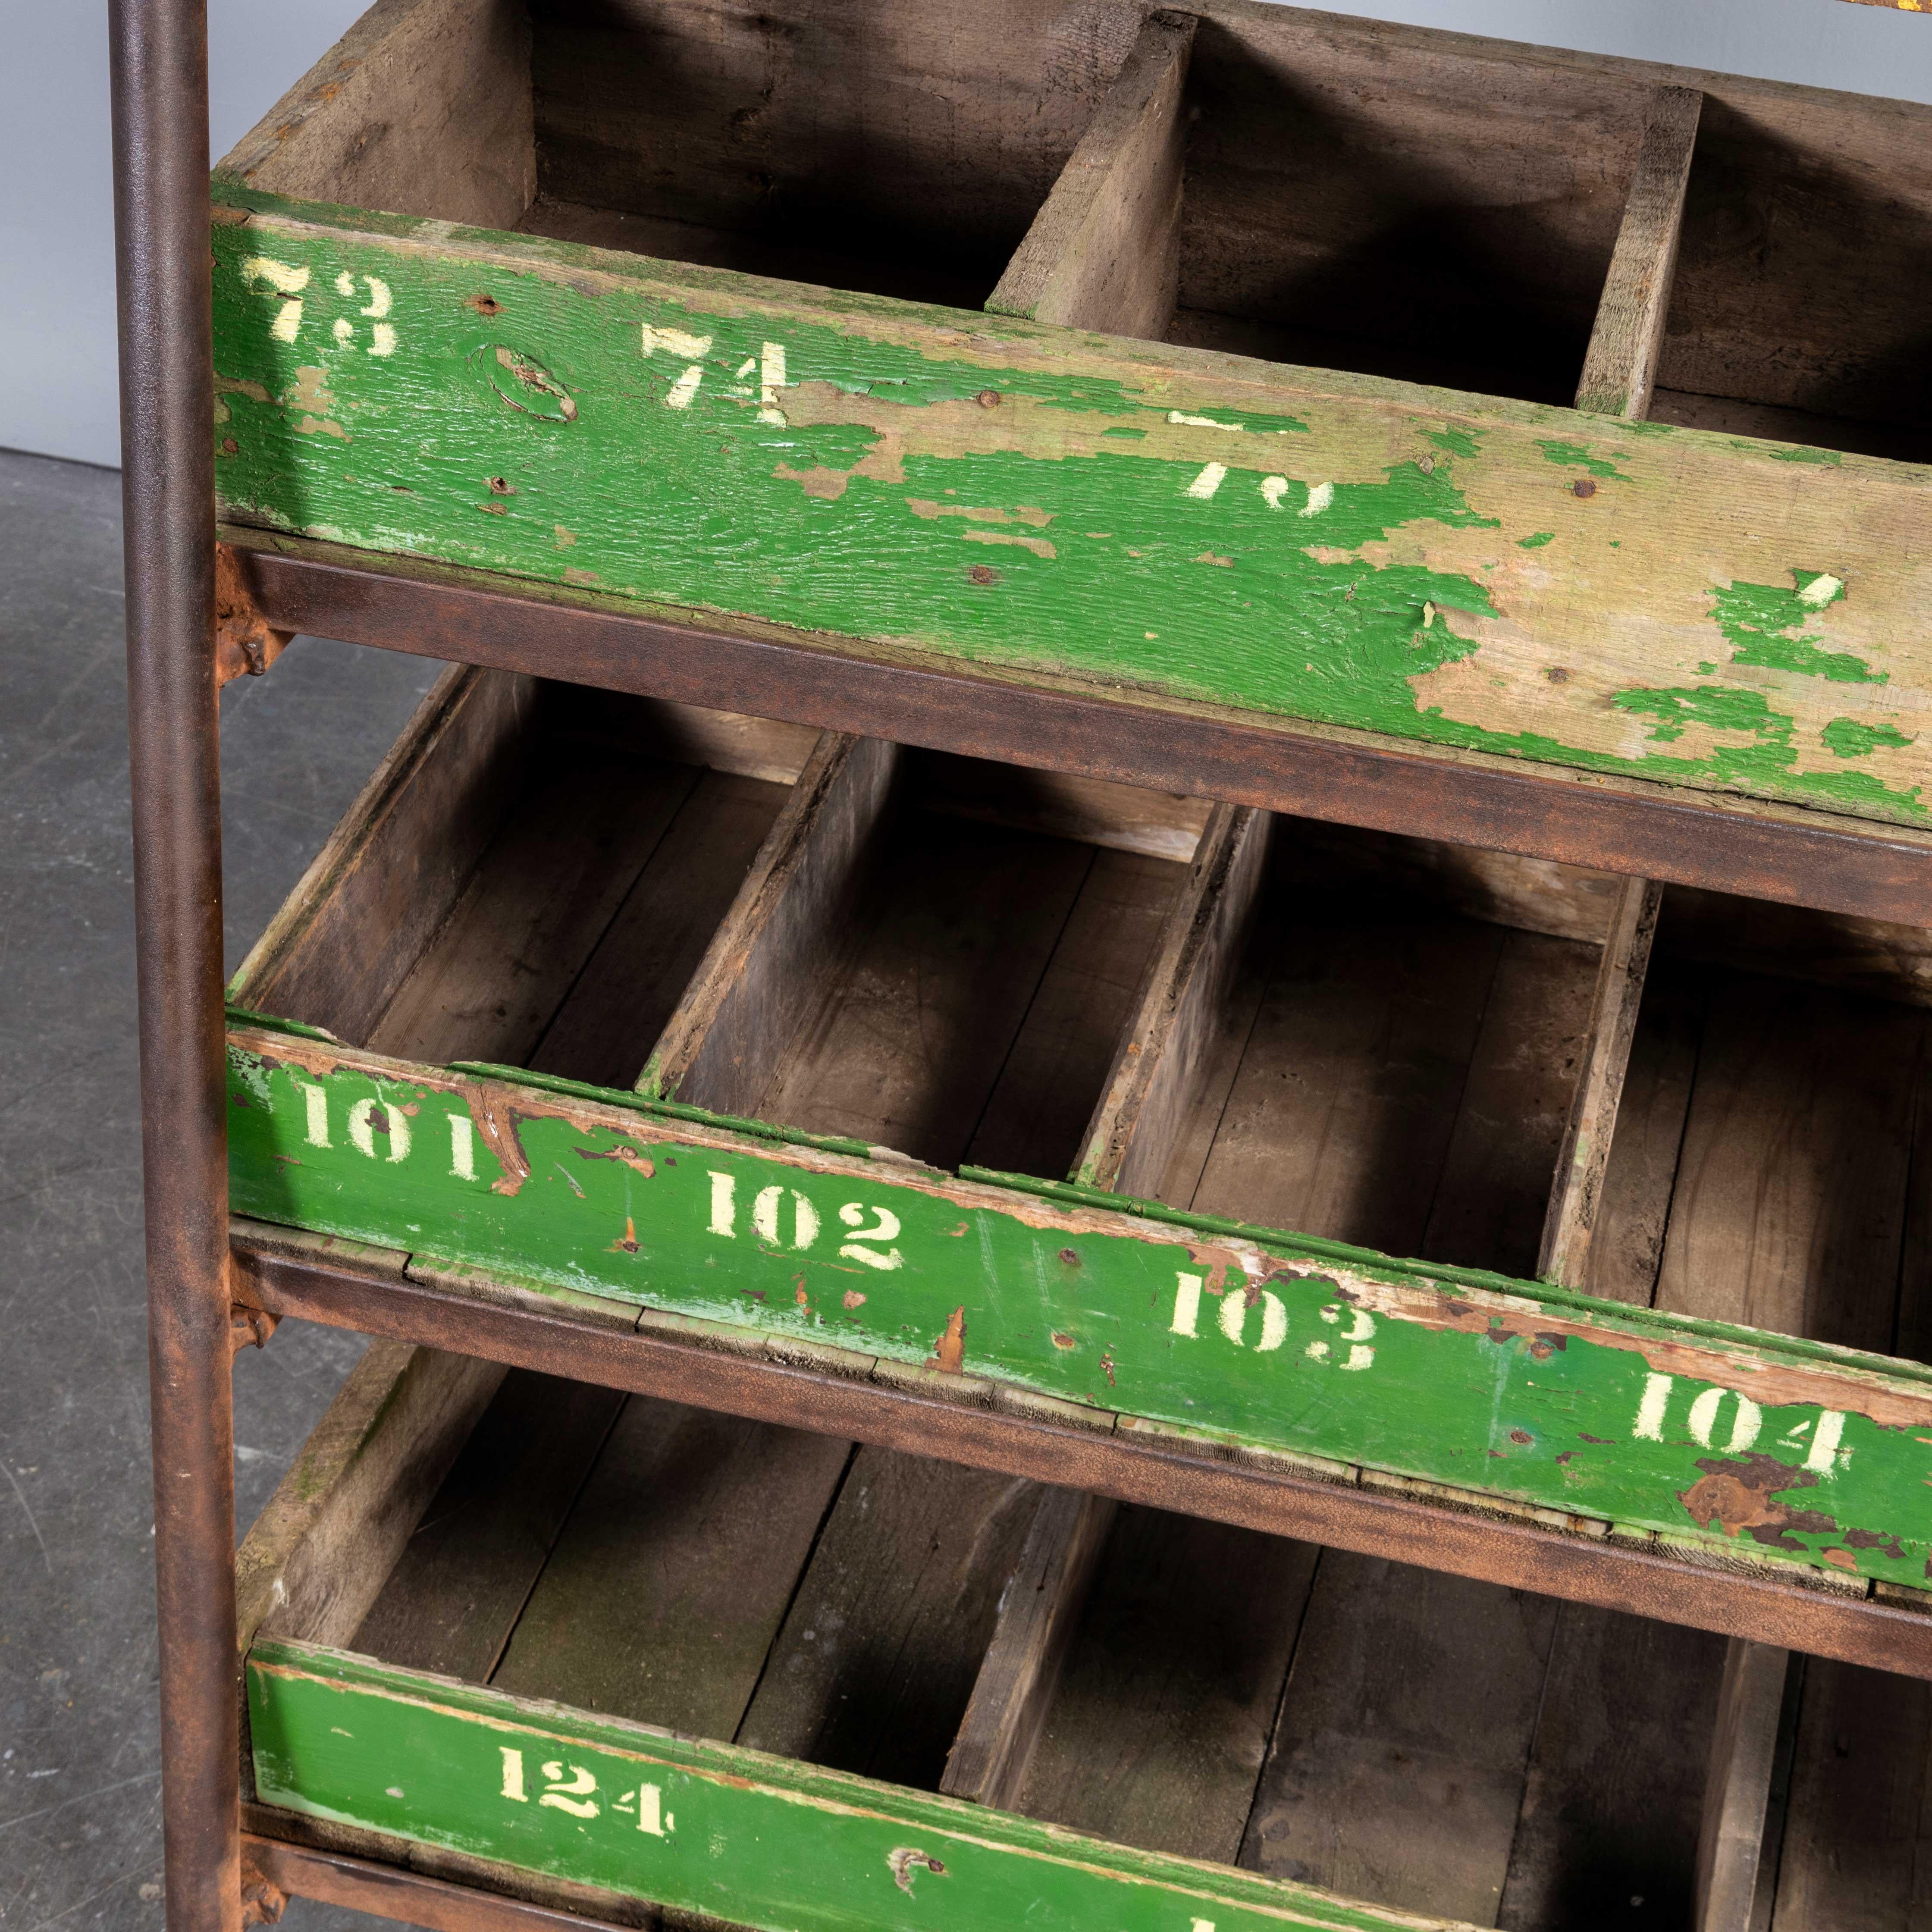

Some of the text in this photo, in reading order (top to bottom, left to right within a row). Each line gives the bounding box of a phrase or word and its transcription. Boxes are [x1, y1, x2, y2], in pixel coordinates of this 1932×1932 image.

[241, 257, 398, 357] 73
[641, 322, 787, 429] 74
[302, 1082, 480, 1182] 101
[706, 1169, 905, 1271] 102
[1168, 1271, 1377, 1372] 103
[1631, 1371, 1854, 1484] 104
[498, 1746, 676, 1838] 124
